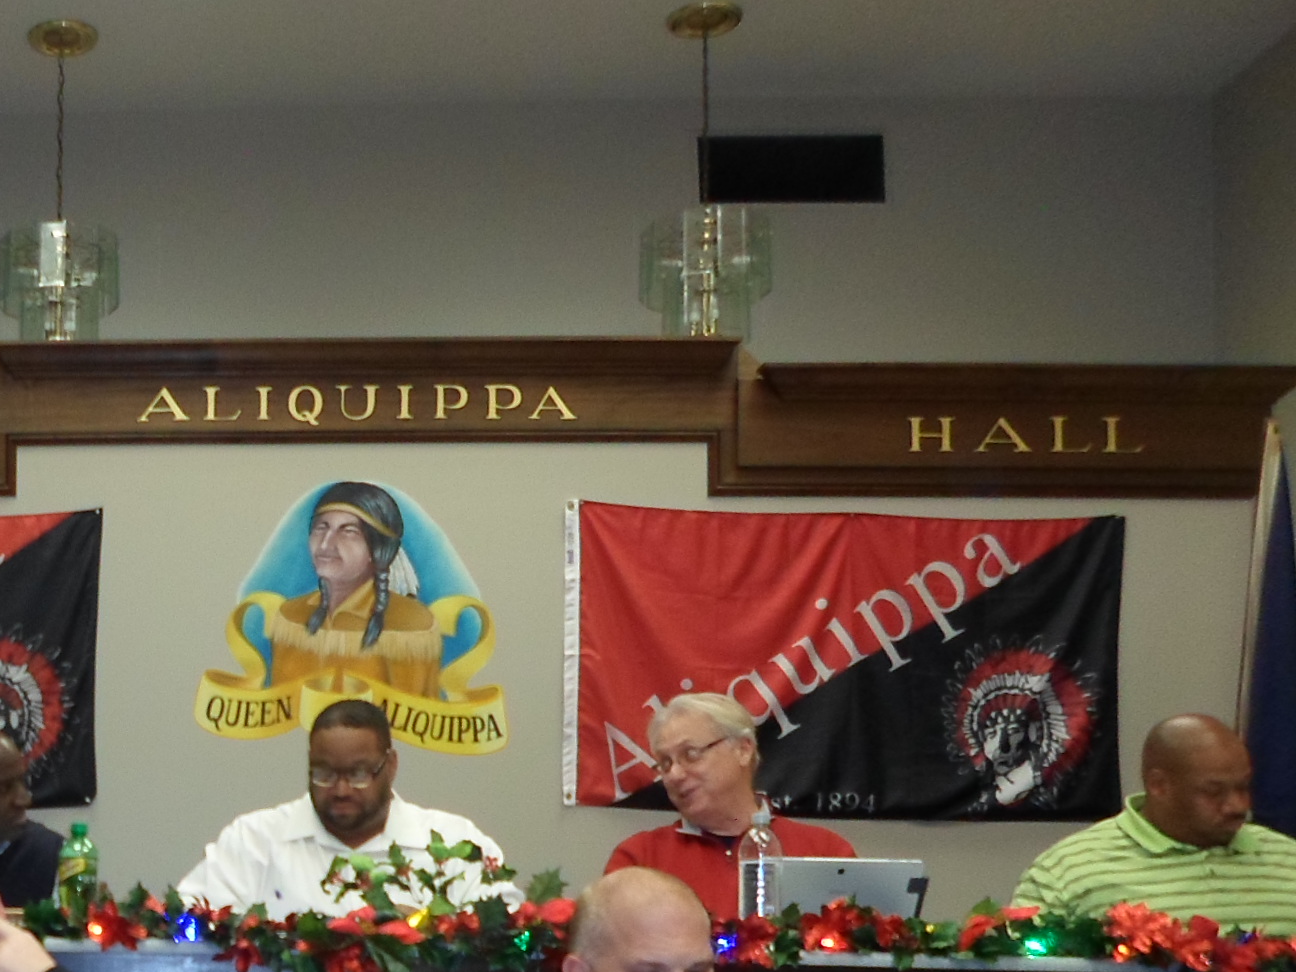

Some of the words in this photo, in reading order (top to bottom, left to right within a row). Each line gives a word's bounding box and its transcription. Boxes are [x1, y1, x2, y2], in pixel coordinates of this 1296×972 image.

[137, 384, 578, 425] ALIQUIPPA
[907, 415, 1145, 454] HALL
[605, 531, 1021, 803] Aquippa
[206, 696, 292, 731] QUEEN
[816, 791, 876, 813] 1894
